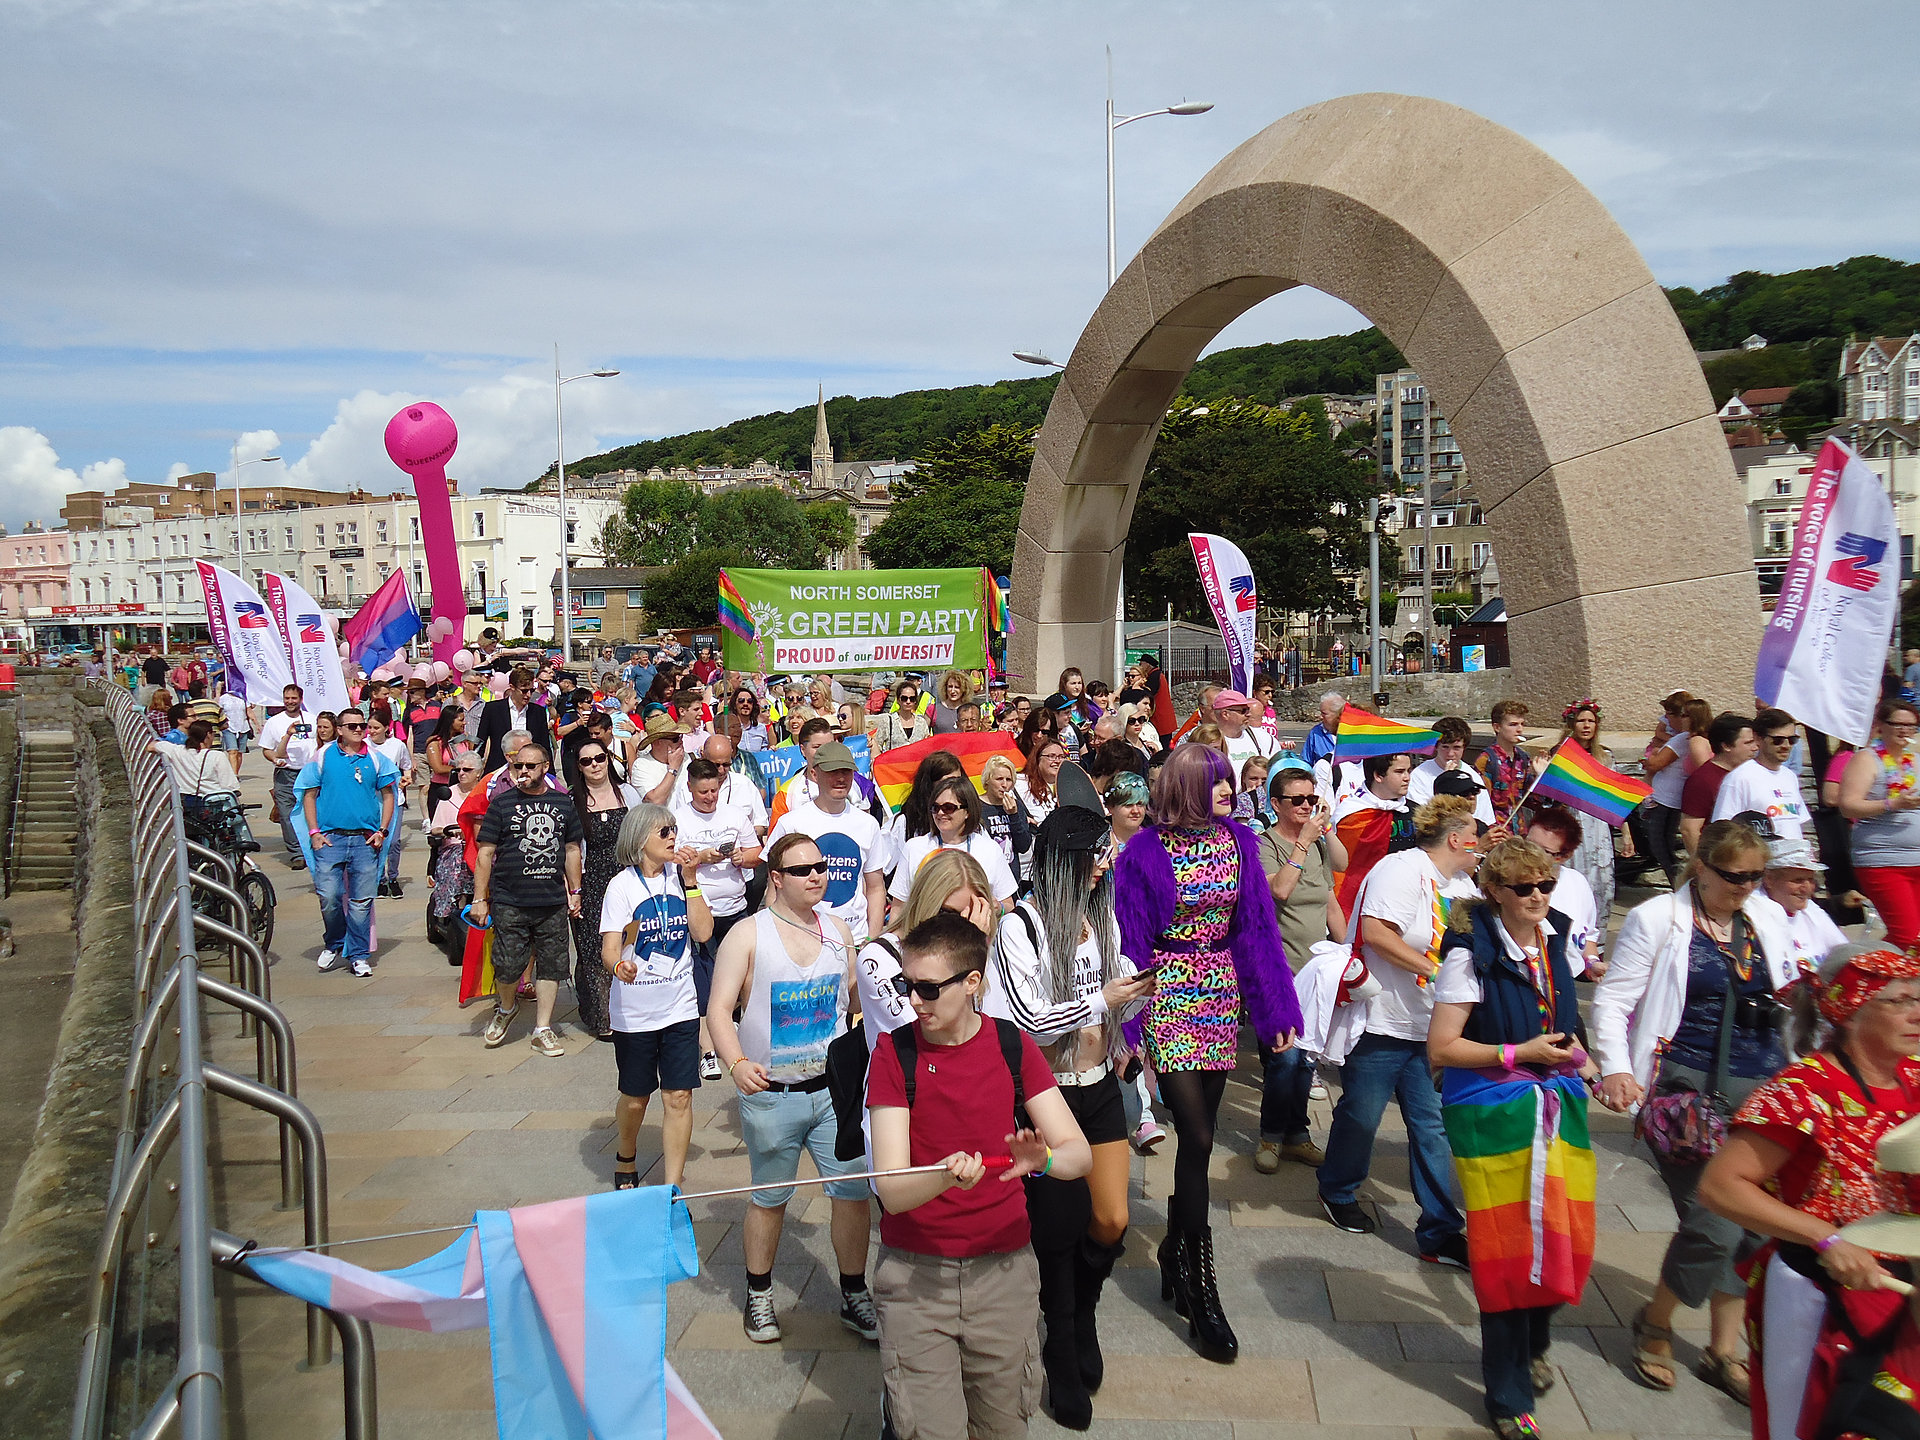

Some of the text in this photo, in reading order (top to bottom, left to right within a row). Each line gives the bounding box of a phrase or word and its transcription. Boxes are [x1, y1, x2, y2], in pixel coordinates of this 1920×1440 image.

[1198, 548, 1210, 572] The
[1774, 467, 1841, 633] The voice of nursing
[203, 573, 216, 591] The
[790, 584, 941, 600] NORTH SOMERSET
[1202, 571, 1219, 606] voice
[208, 589, 222, 617] voice
[271, 584, 283, 605] The
[213, 616, 227, 633] of
[788, 608, 978, 636] GREEN PARTY
[1222, 617, 1243, 667] nursing
[776, 643, 953, 664] PROUD of our DIVERSITY
[256, 650, 269, 680] College
[305, 658, 315, 687] Nursing
[313, 646, 327, 697] Royal College
[760, 754, 792, 776] nity
[852, 750, 869, 759] Mare
[510, 802, 566, 831] BREAKNECK
[534, 816, 546, 825] CO
[987, 815, 1011, 826] TRA
[522, 865, 557, 876] Custom
[822, 854, 858, 867] tizens
[827, 868, 852, 881] vice
[639, 914, 689, 932] citiens
[1072, 969, 1103, 987] ALOUS
[779, 984, 835, 1002] CANCUN
